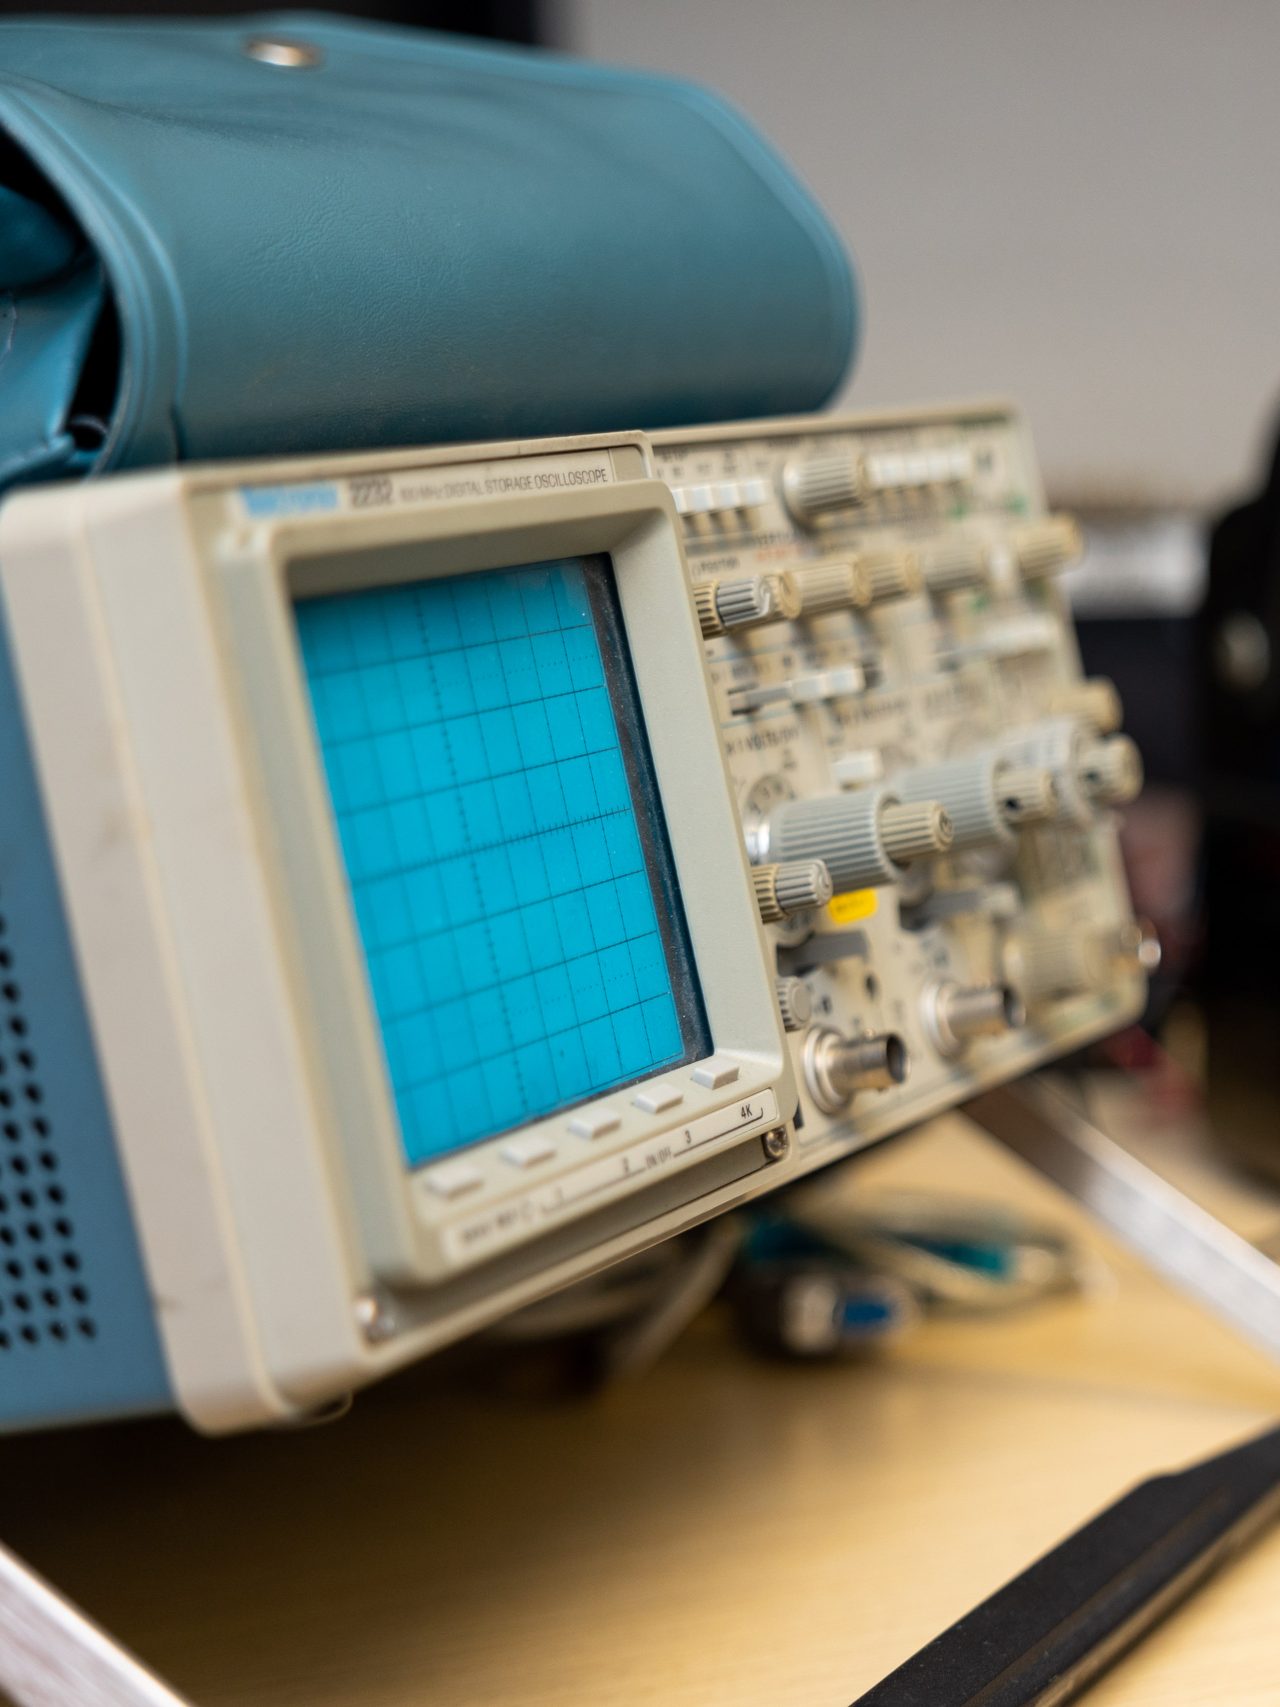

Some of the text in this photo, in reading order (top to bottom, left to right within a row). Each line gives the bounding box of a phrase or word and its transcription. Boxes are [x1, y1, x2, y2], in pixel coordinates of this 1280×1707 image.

[443, 480, 483, 499] DIGITAL
[485, 475, 532, 495] STORAGE
[534, 468, 608, 489] OSCILLOSCOPE
[646, 1146, 672, 1169] ON/OFF
[684, 1130, 692, 1144] 3
[740, 1103, 753, 1119] 4K
